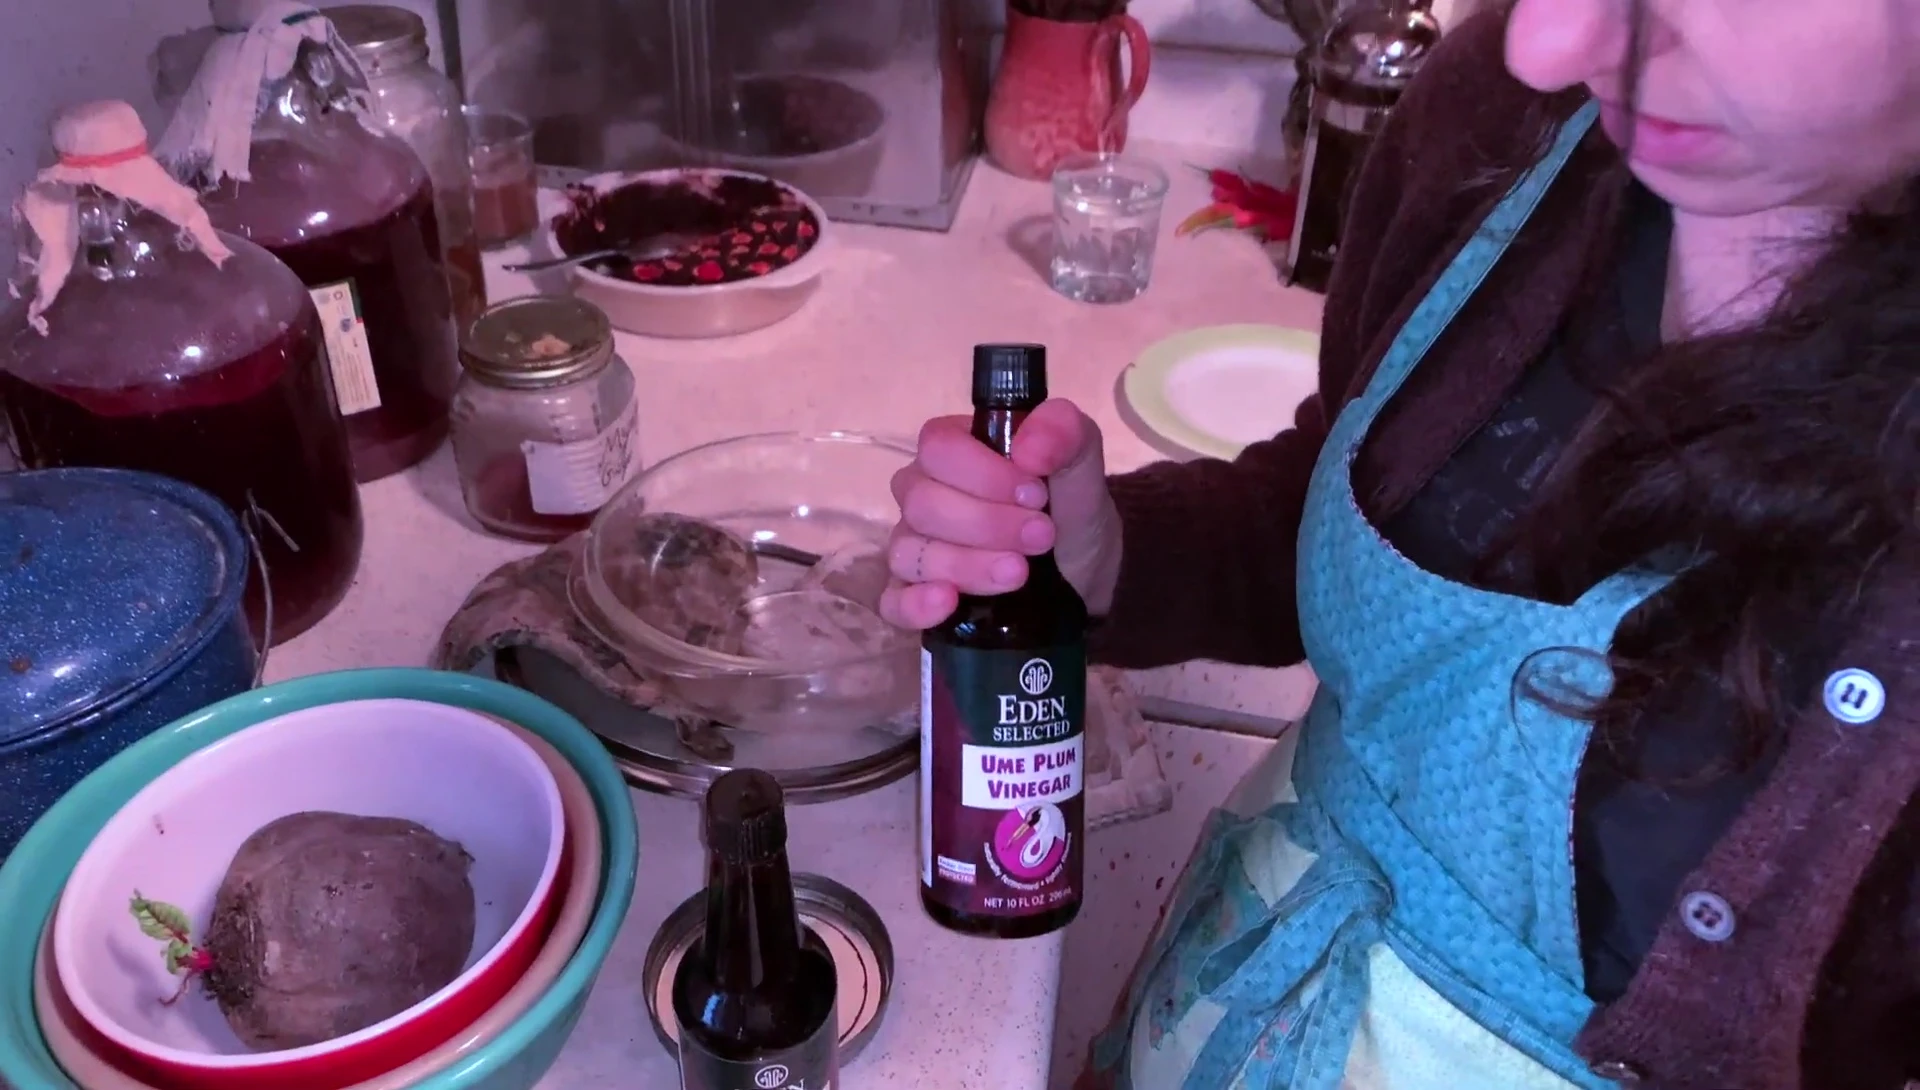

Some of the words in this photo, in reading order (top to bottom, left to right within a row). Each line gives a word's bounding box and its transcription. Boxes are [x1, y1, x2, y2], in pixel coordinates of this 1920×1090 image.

[997, 695, 1066, 724] EDEN
[993, 720, 1071, 742] SELECTED
[981, 754, 1026, 775] UME
[1033, 747, 1077, 773] PLUM
[987, 774, 1071, 799] VINEGAR
[984, 897, 1004, 908] NET
[1007, 897, 1018, 909] 10
[1019, 896, 1030, 908] FL
[1031, 894, 1044, 906] OZ
